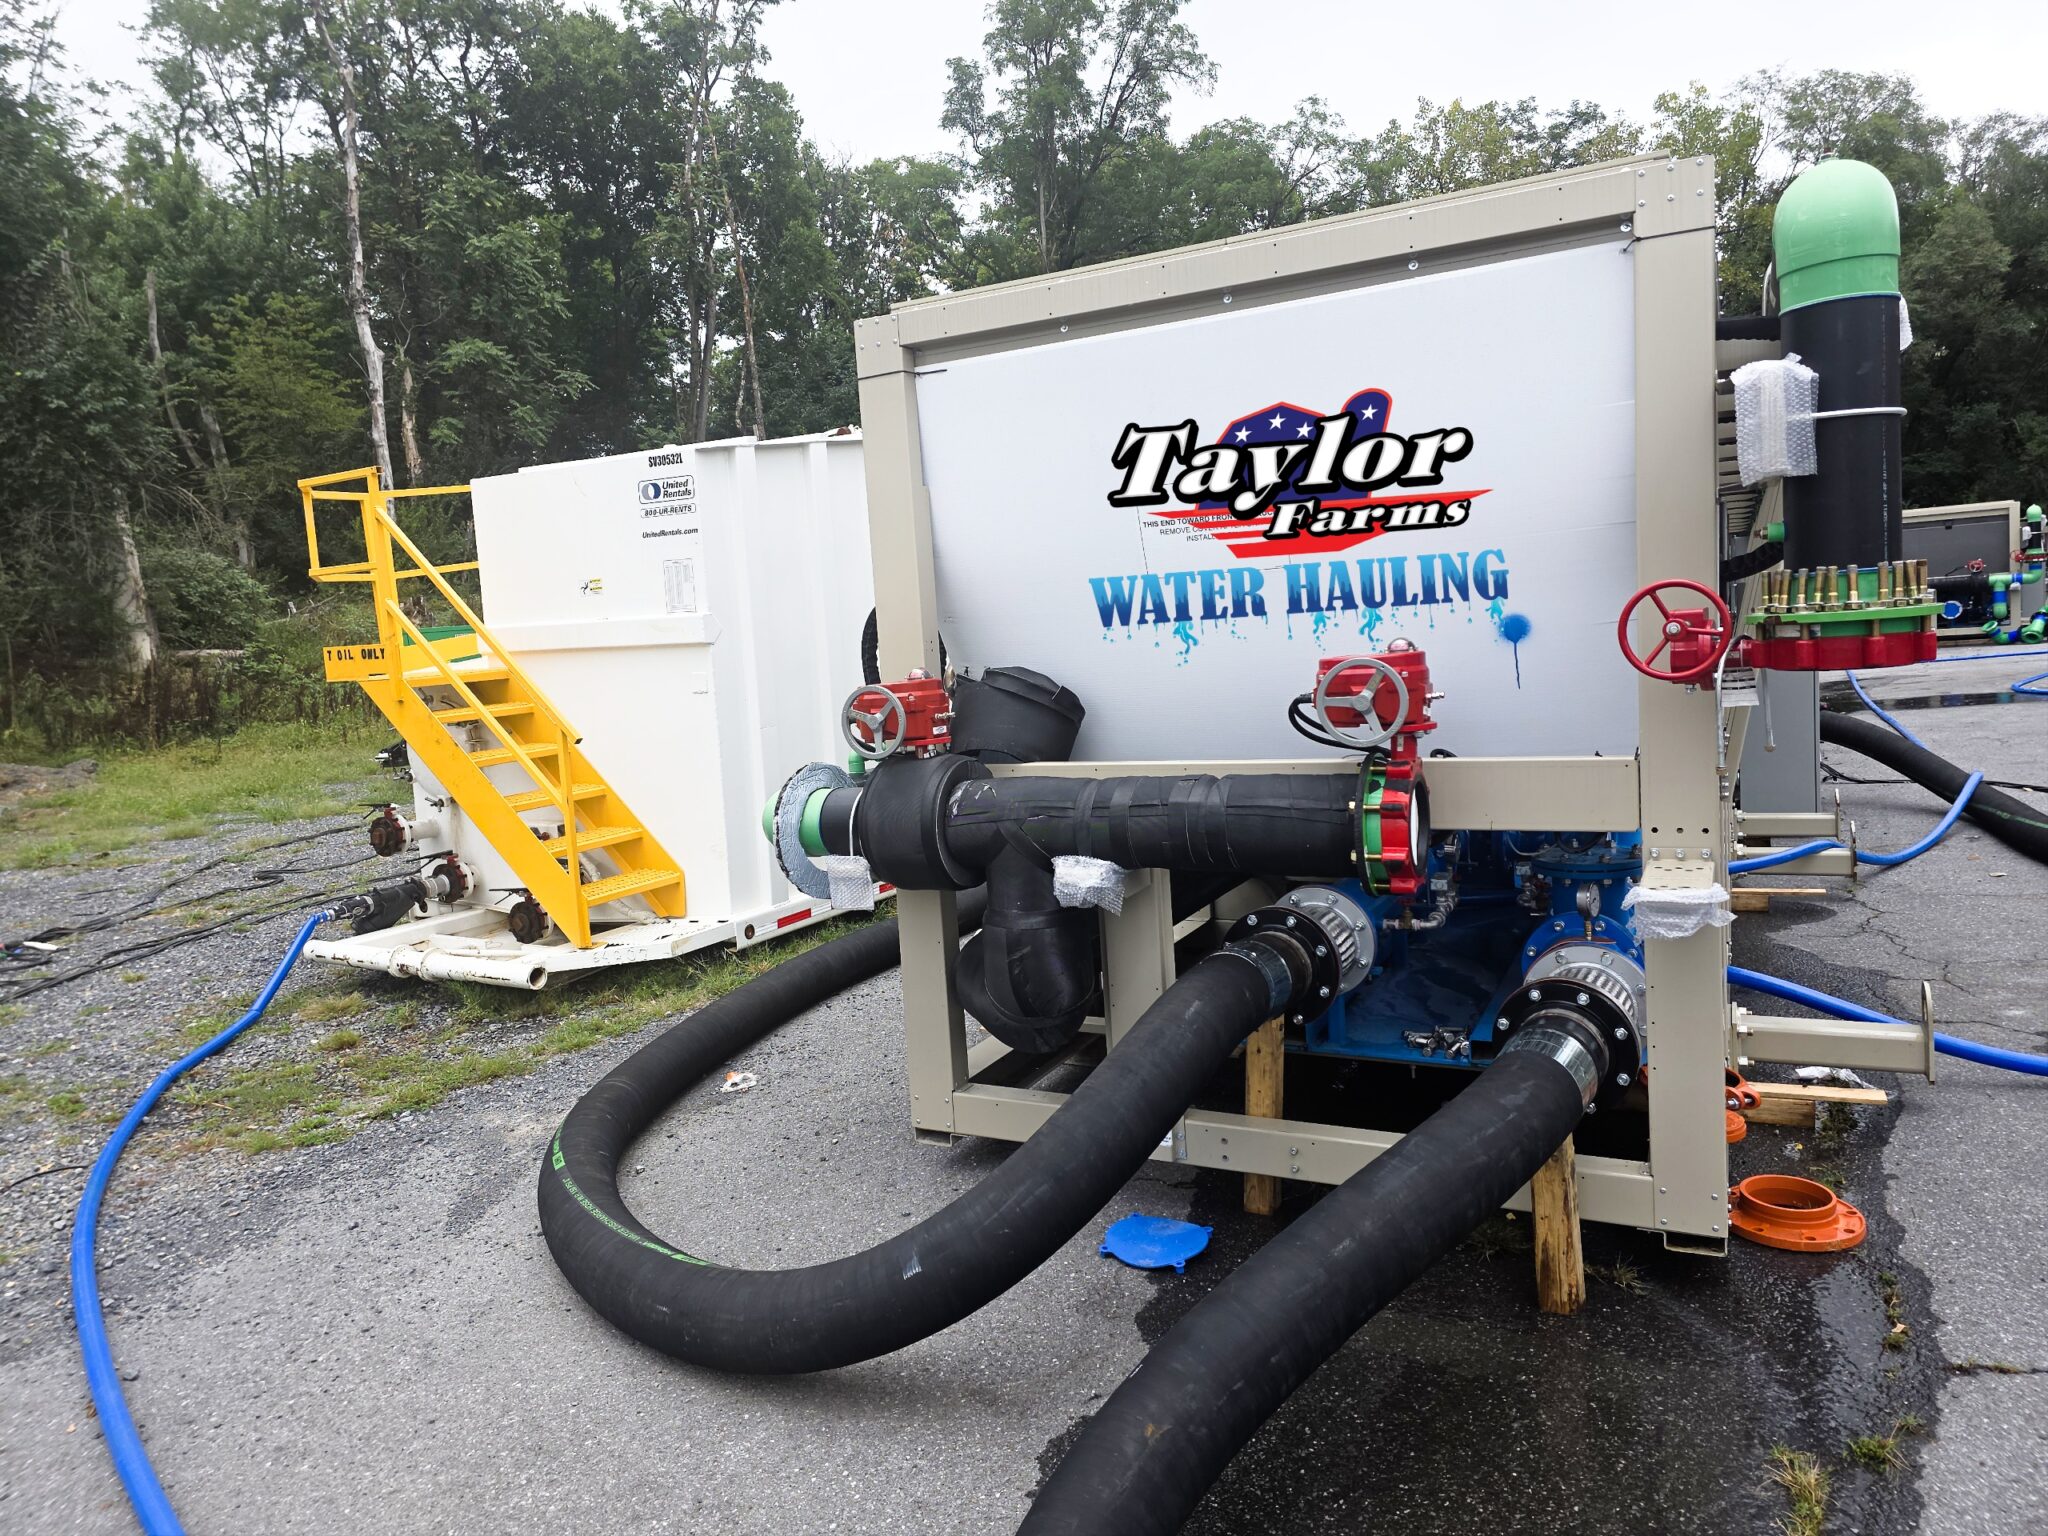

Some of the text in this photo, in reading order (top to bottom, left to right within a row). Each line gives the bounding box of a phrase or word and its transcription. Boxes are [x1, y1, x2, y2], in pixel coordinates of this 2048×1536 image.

[1107, 411, 1473, 521] Taylor
[662, 478, 689, 490] United
[663, 487, 692, 499] Rentals
[644, 504, 692, 517] 800-UR-RENTS
[1160, 519, 1176, 527] END
[1177, 515, 1210, 525] TOWARD
[1263, 497, 1472, 541] Farms
[642, 528, 699, 539] UnitedRentals.com
[1160, 526, 1191, 536] REMOVE
[1089, 548, 1510, 629] WATER HAULING
[337, 648, 354, 661] OIL
[361, 647, 385, 660] ONLY
